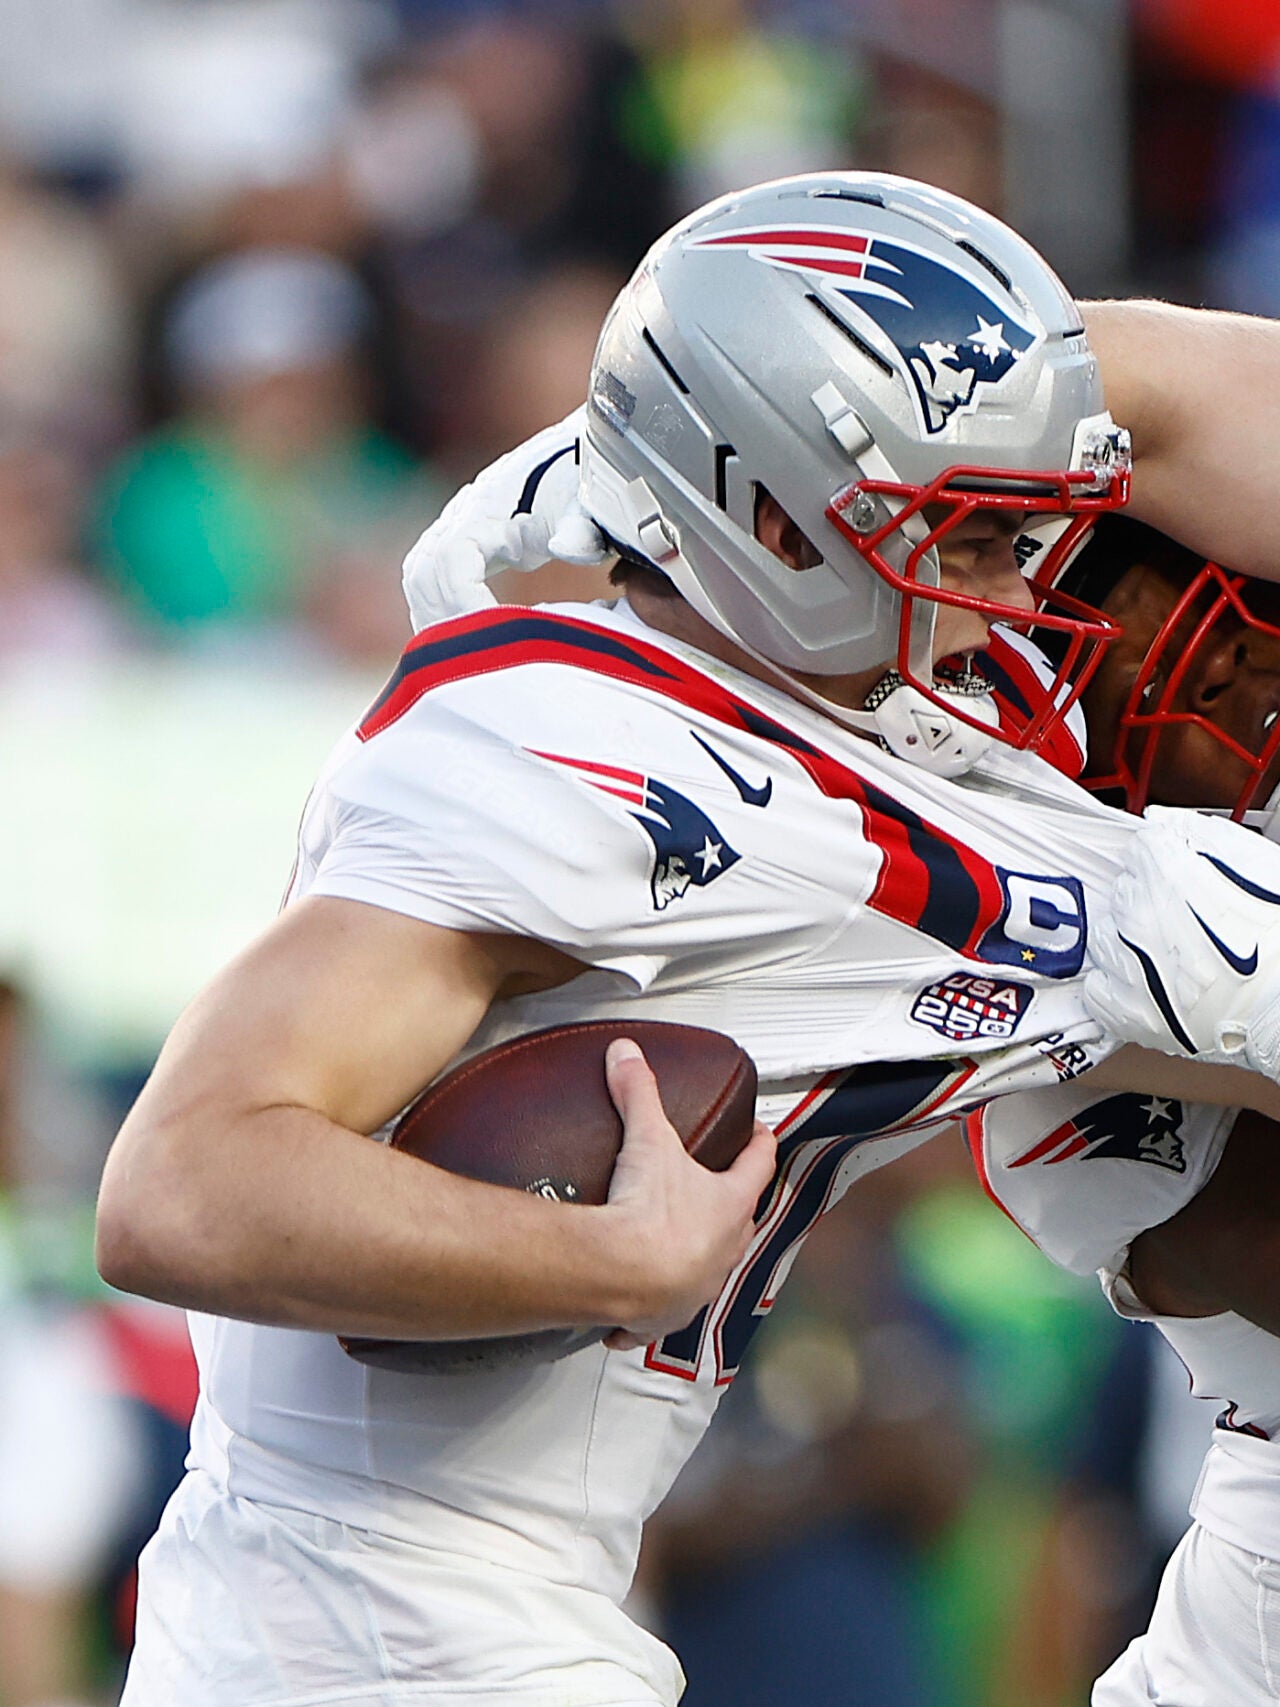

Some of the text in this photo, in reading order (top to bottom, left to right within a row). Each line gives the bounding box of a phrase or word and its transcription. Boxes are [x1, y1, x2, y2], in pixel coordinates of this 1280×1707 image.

[1003, 874, 1081, 953] C
[913, 994, 1014, 1039] 250
[942, 975, 1021, 1013] USA
